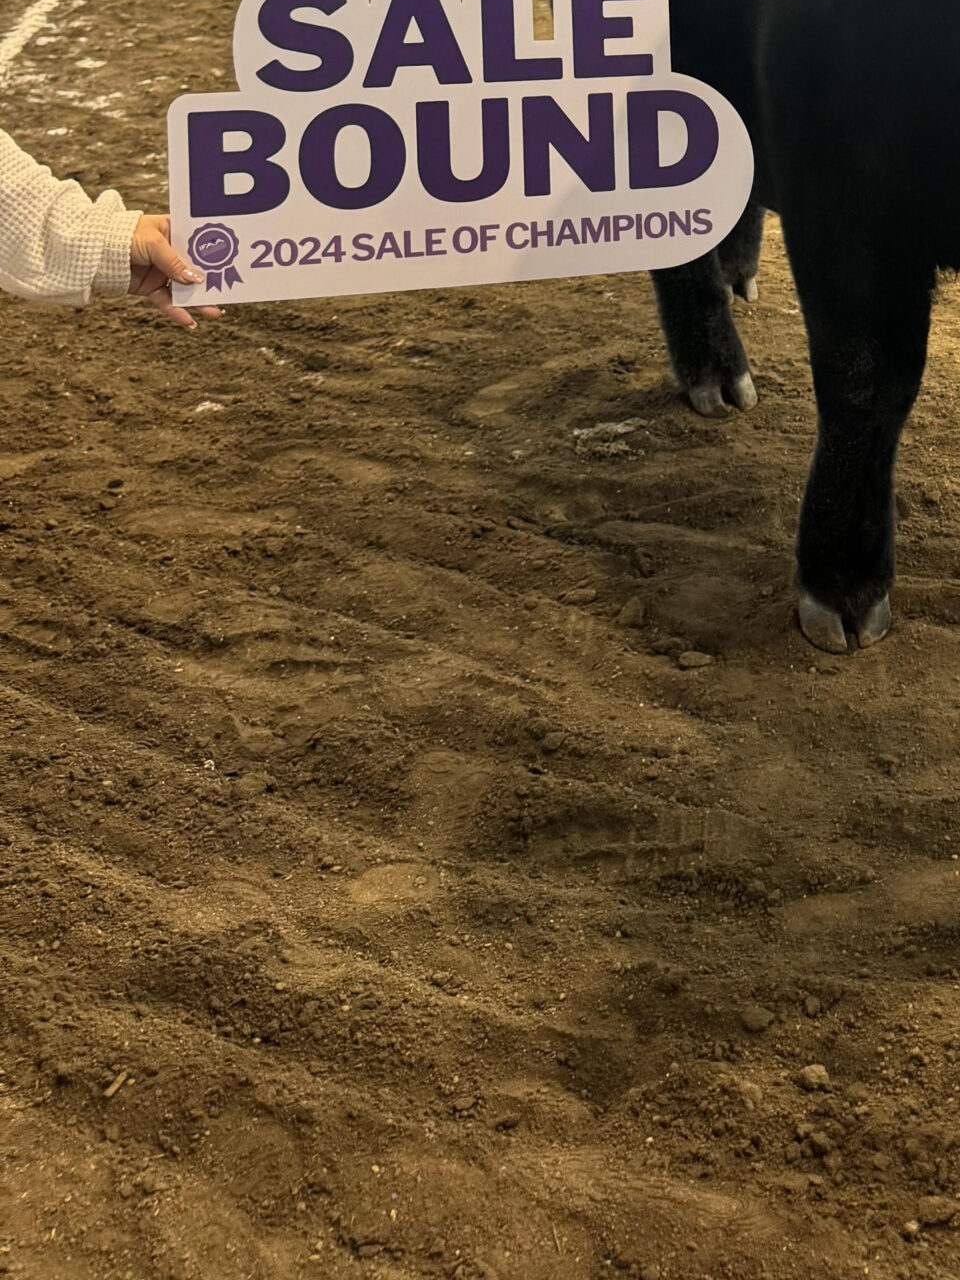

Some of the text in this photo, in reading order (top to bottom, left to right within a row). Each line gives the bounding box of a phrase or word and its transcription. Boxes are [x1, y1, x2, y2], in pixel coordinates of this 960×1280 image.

[187, 90, 719, 218] BOUND
[250, 235, 346, 269] 2024
[351, 227, 447, 262] SALE
[452, 223, 500, 254] OF
[505, 208, 713, 250] CHAMPIONS
